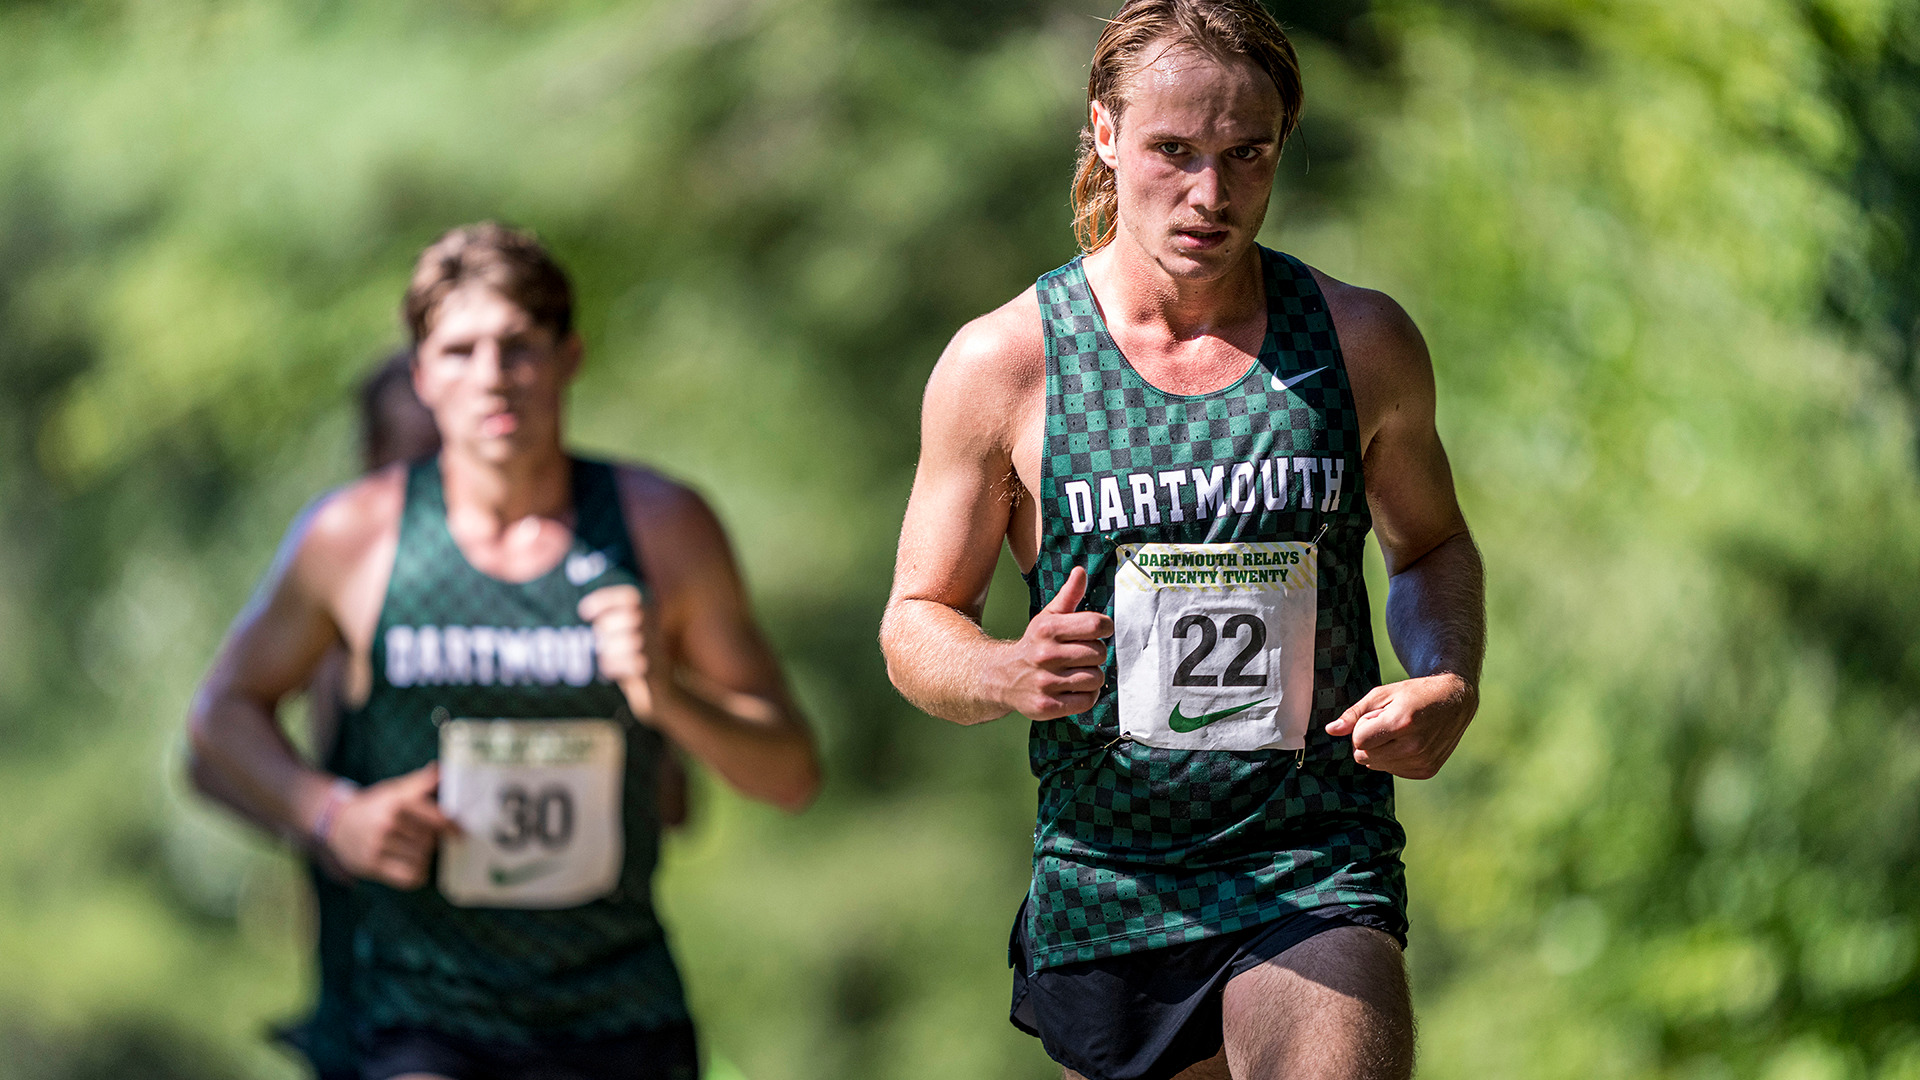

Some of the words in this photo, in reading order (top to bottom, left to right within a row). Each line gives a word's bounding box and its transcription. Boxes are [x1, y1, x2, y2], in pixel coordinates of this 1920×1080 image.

[1064, 456, 1345, 534] DARTMOUTH
[1138, 553, 1238, 567] DARTMOUTH
[1242, 551, 1300, 566] RELAYS
[1151, 570, 1219, 584] TWENTY
[1223, 569, 1289, 583] TWENTY
[1172, 613, 1268, 687] 22
[496, 783, 573, 851] 30
